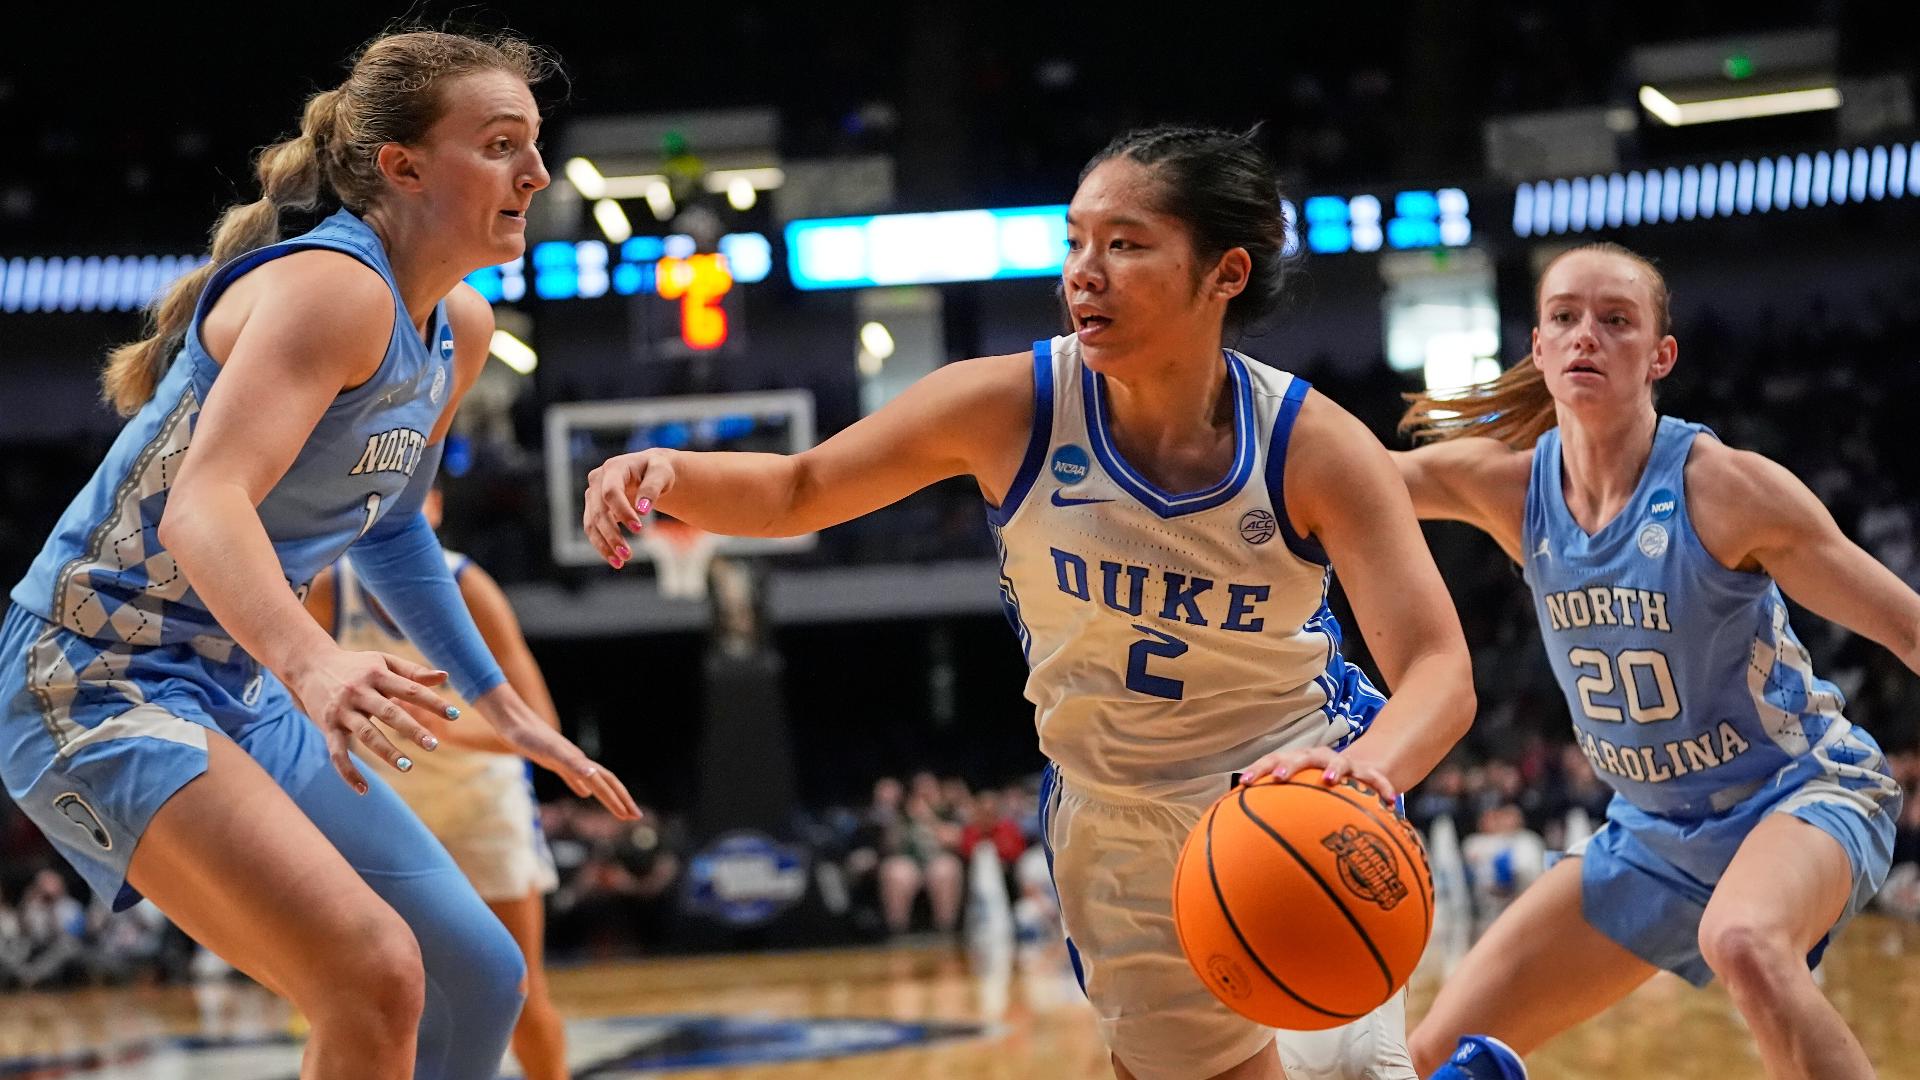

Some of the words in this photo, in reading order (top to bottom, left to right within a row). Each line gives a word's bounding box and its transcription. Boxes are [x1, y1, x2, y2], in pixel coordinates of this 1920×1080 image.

[1054, 460, 1086, 476] NCAA
[1244, 519, 1275, 530] ACC
[1050, 546, 1271, 633] DUKE
[1546, 586, 1671, 632] NORTH
[1126, 623, 1189, 701] 2
[1568, 647, 1681, 724] 20
[1345, 849, 1399, 909] MADNESS
[1352, 834, 1395, 881] MARCH
